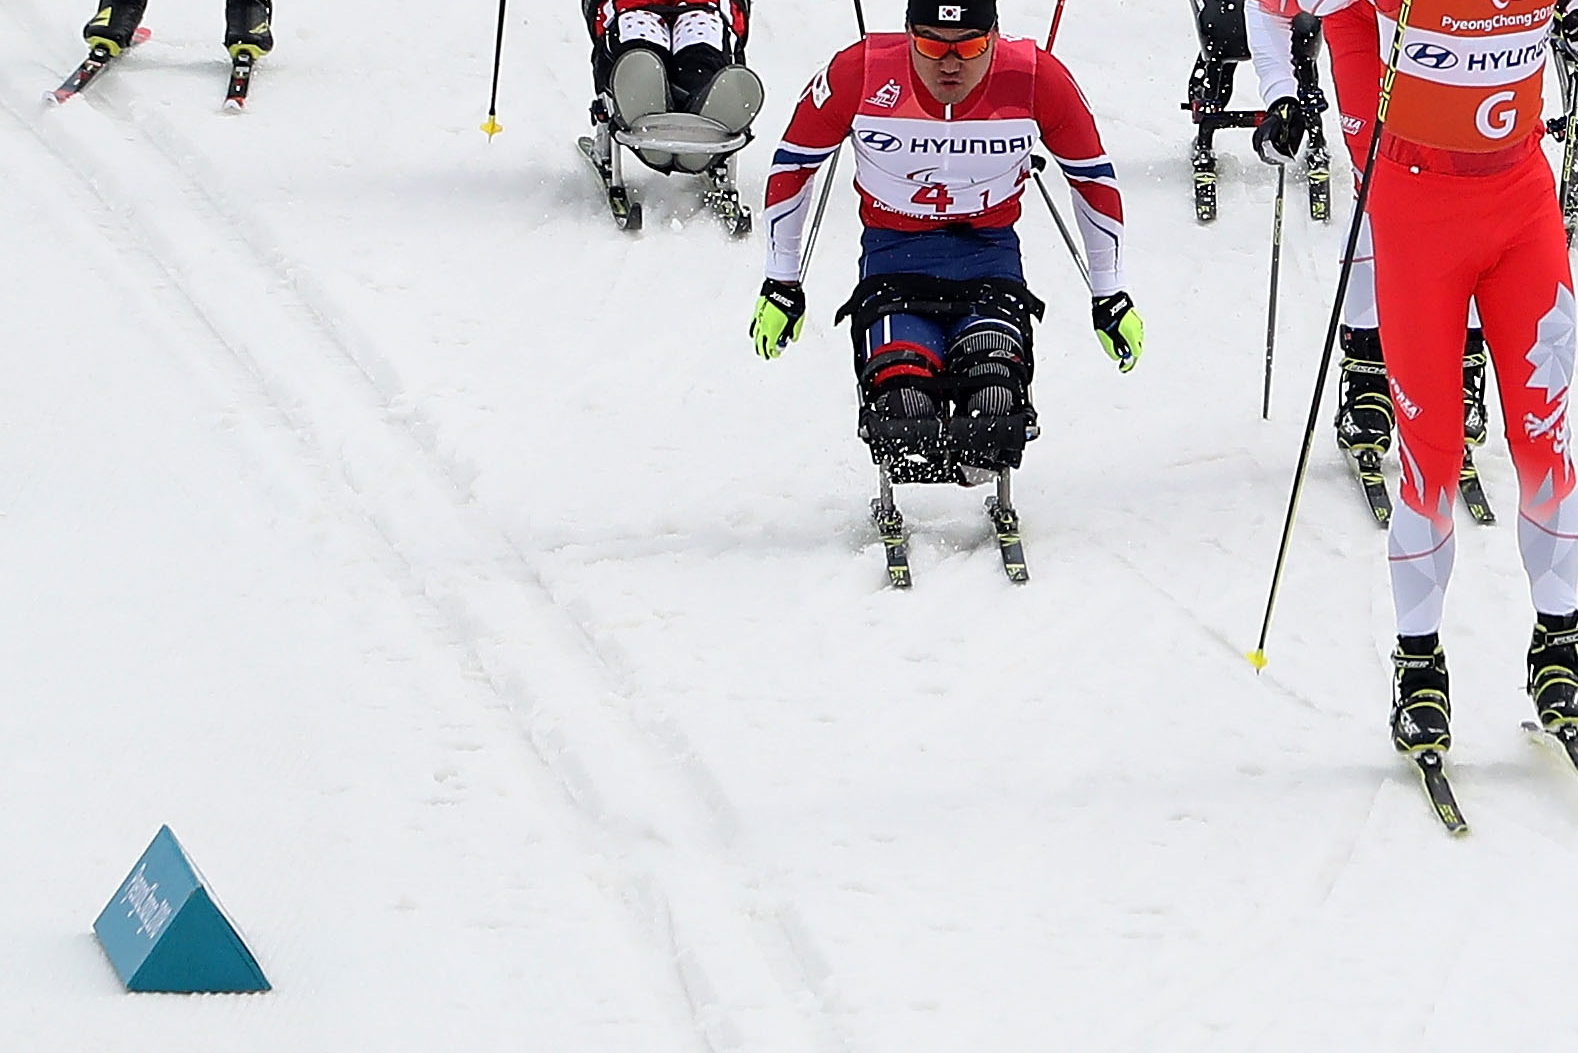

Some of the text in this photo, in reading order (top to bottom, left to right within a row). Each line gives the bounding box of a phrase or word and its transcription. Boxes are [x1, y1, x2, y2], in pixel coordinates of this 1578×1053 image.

[1441, 13, 1532, 31] PyeongChang
[1467, 36, 1549, 71] HYUN
[1475, 90, 1518, 140] G
[910, 134, 1033, 155] HYUNDAI
[911, 182, 954, 213] 4
[979, 189, 991, 210] 1
[1395, 660, 1430, 669] CHER
